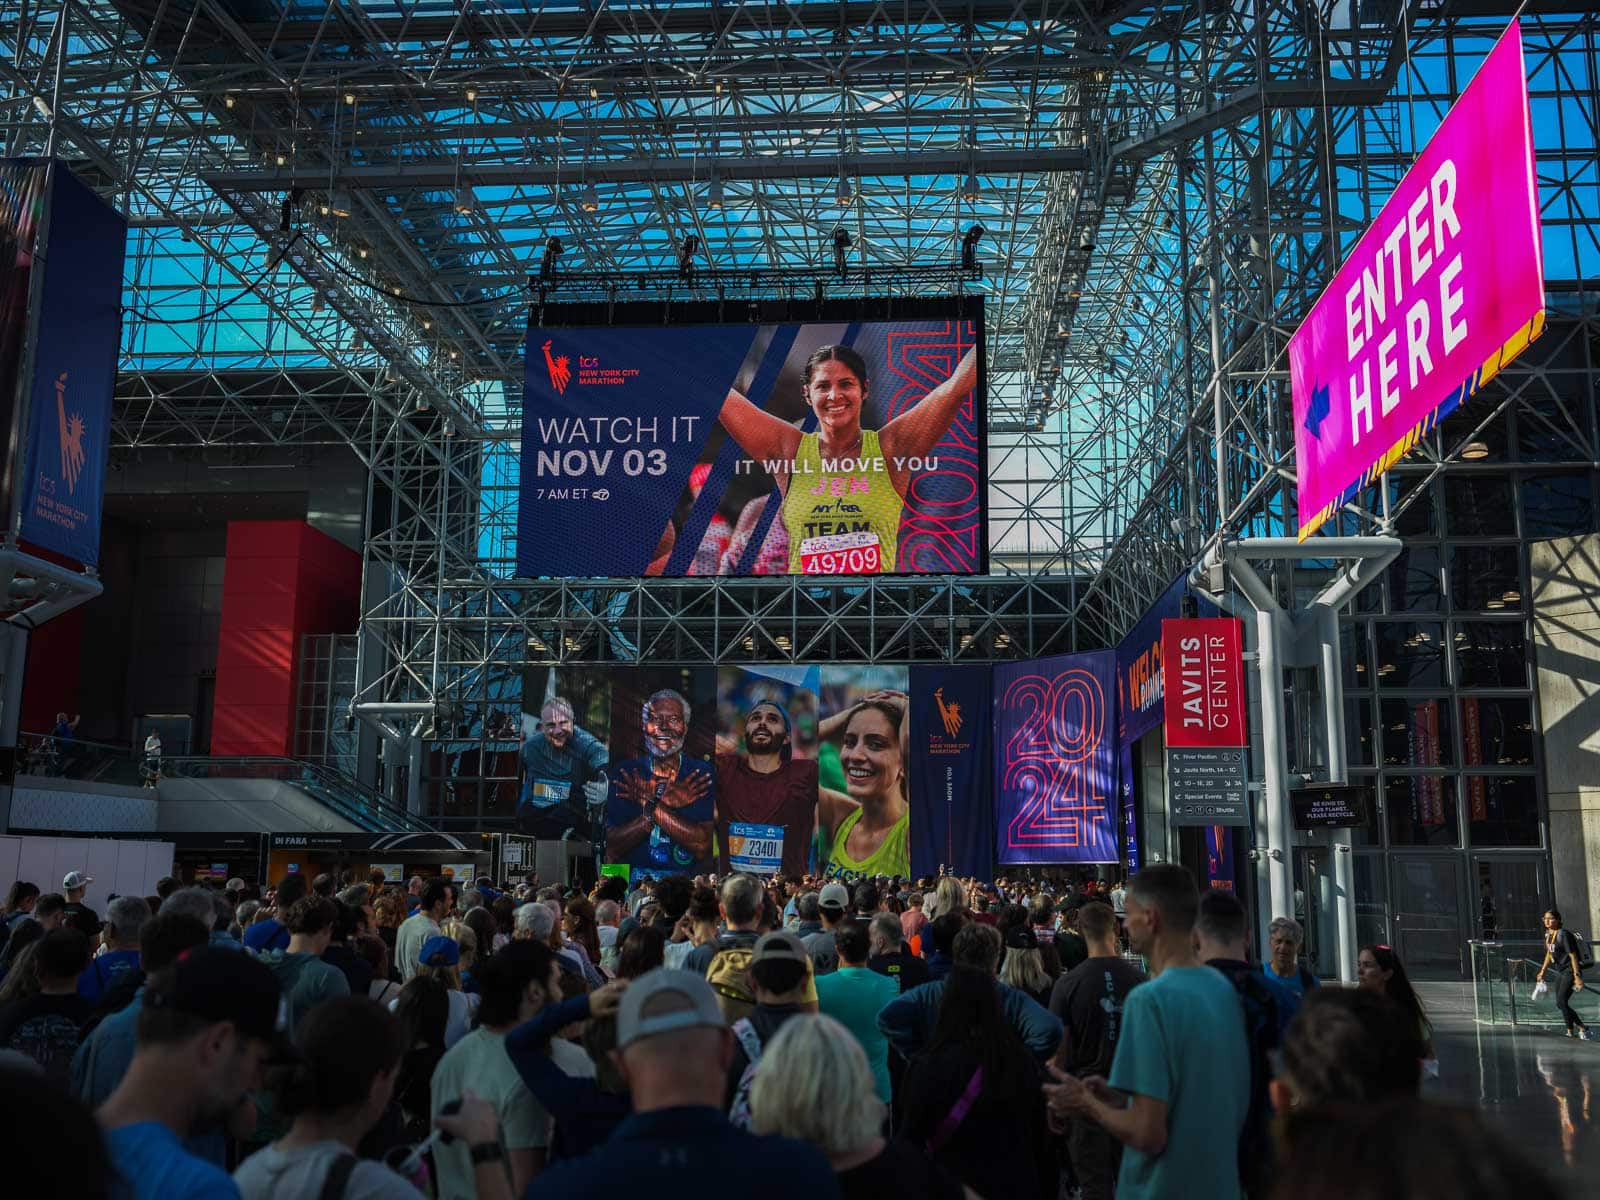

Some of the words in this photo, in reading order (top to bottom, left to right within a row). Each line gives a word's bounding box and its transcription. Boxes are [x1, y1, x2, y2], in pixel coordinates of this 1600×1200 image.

[1345, 159, 1462, 362] ENTER
[579, 355, 599, 368] tcs
[1350, 252, 1468, 447] HERE
[538, 417, 658, 444] WATCH
[672, 416, 700, 442] IT
[537, 450, 613, 476] NOV
[623, 449, 667, 476] 03
[735, 460, 754, 474] IT
[763, 459, 814, 474] WILL
[822, 458, 884, 472] MOVE
[893, 456, 938, 472] YOU
[537, 489, 544, 500] 7
[549, 489, 568, 500] AM
[572, 488, 588, 500] ET
[810, 476, 870, 496] JEN
[804, 522, 870, 538] TEAM
[807, 547, 878, 574] 49709
[1129, 640, 1164, 712] WELC
[1180, 637, 1204, 728] JAVITS
[1210, 636, 1229, 728] CENTER
[275, 837, 284, 845] DI
[285, 837, 307, 845] FARA
[749, 840, 777, 858] 23401
